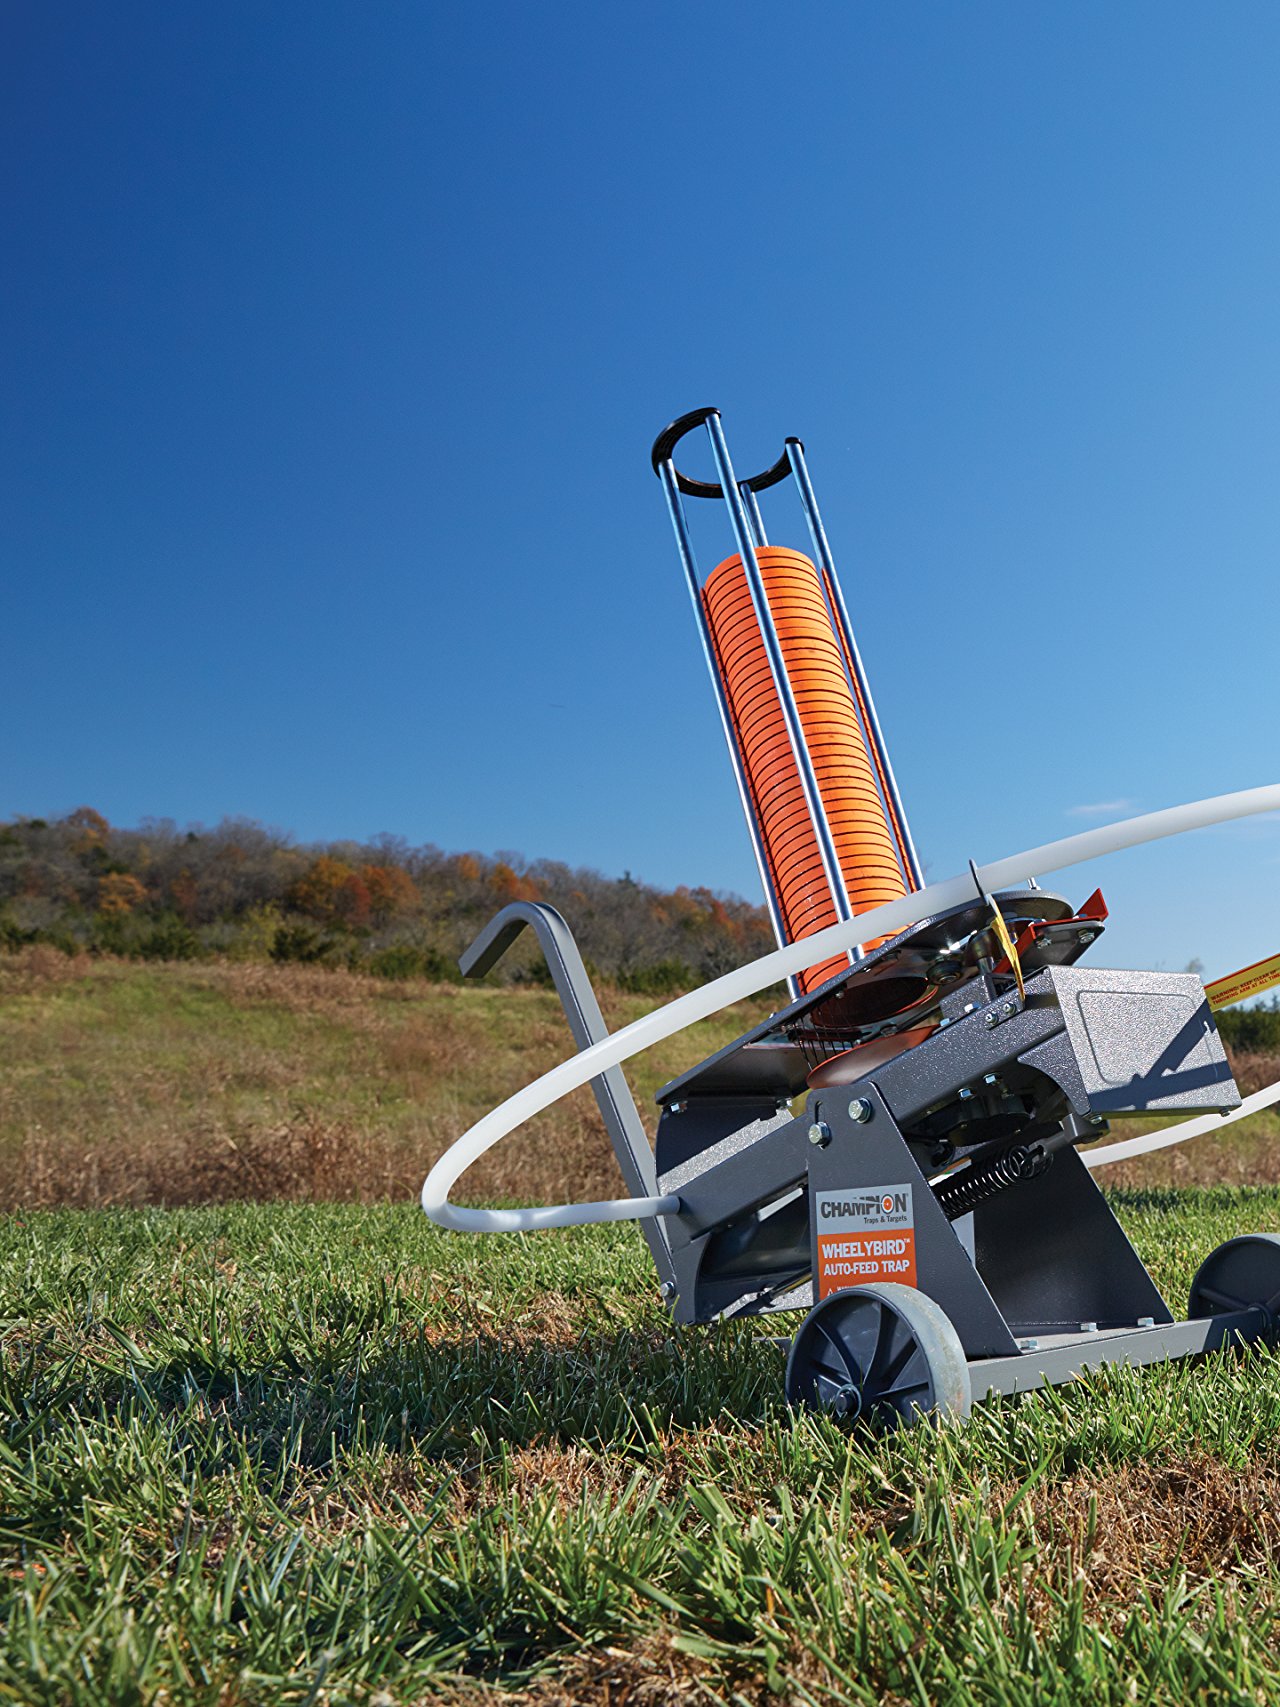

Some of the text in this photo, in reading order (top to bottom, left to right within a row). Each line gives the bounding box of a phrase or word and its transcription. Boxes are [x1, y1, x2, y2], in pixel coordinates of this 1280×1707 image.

[1239, 985, 1251, 994] ARM
[820, 1193, 907, 1219] CHAMPION
[863, 1214, 908, 1225] Traps & Targets
[823, 1259, 910, 1276] AUTO-FEED TRAP
